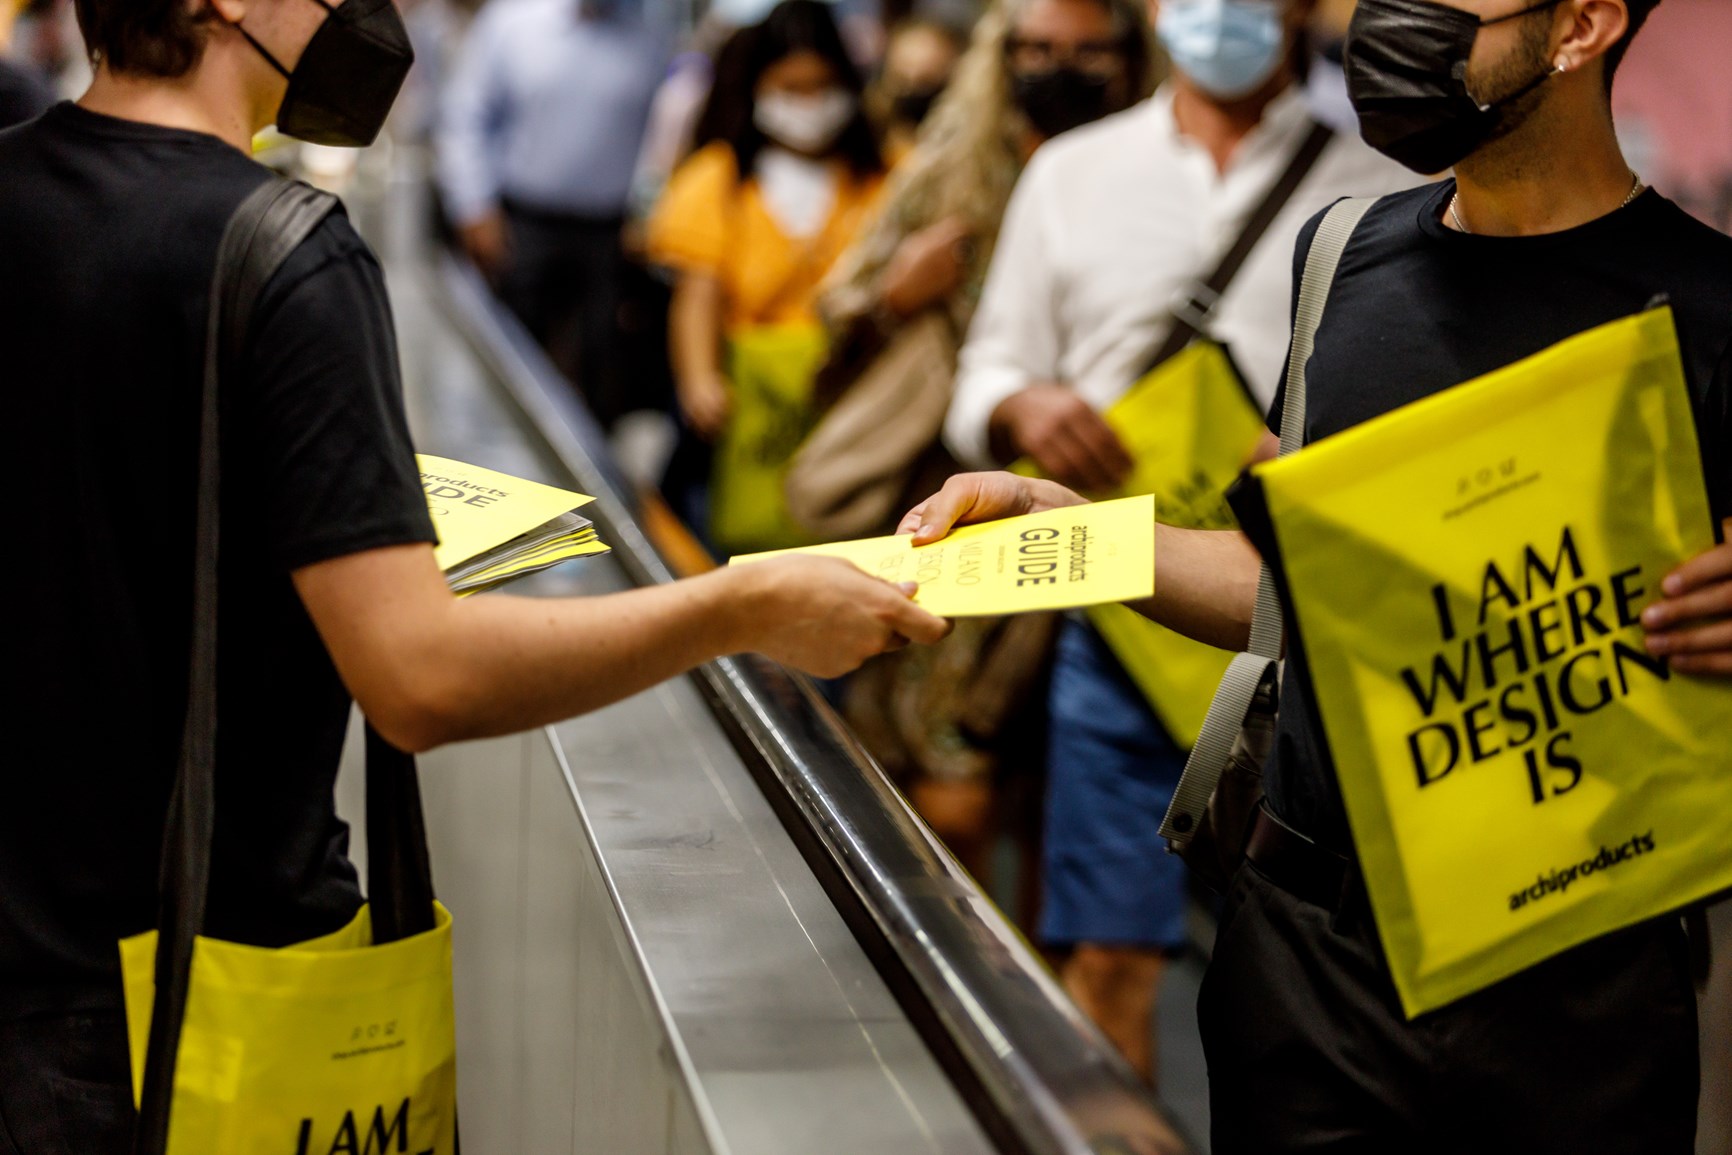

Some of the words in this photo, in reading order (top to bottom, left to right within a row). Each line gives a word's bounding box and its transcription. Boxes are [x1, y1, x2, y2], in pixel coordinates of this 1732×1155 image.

[1017, 528, 1060, 587] GUIDE
[1064, 526, 1094, 582] archiproducts
[1431, 583, 1456, 641] I
[1478, 525, 1585, 625] AM
[1400, 566, 1649, 718] WHERE
[1407, 640, 1671, 788] DESIGN
[1523, 731, 1583, 805] IS
[1509, 830, 1656, 912] archiproducts
[296, 1117, 313, 1155] I
[327, 1097, 410, 1155] AM
